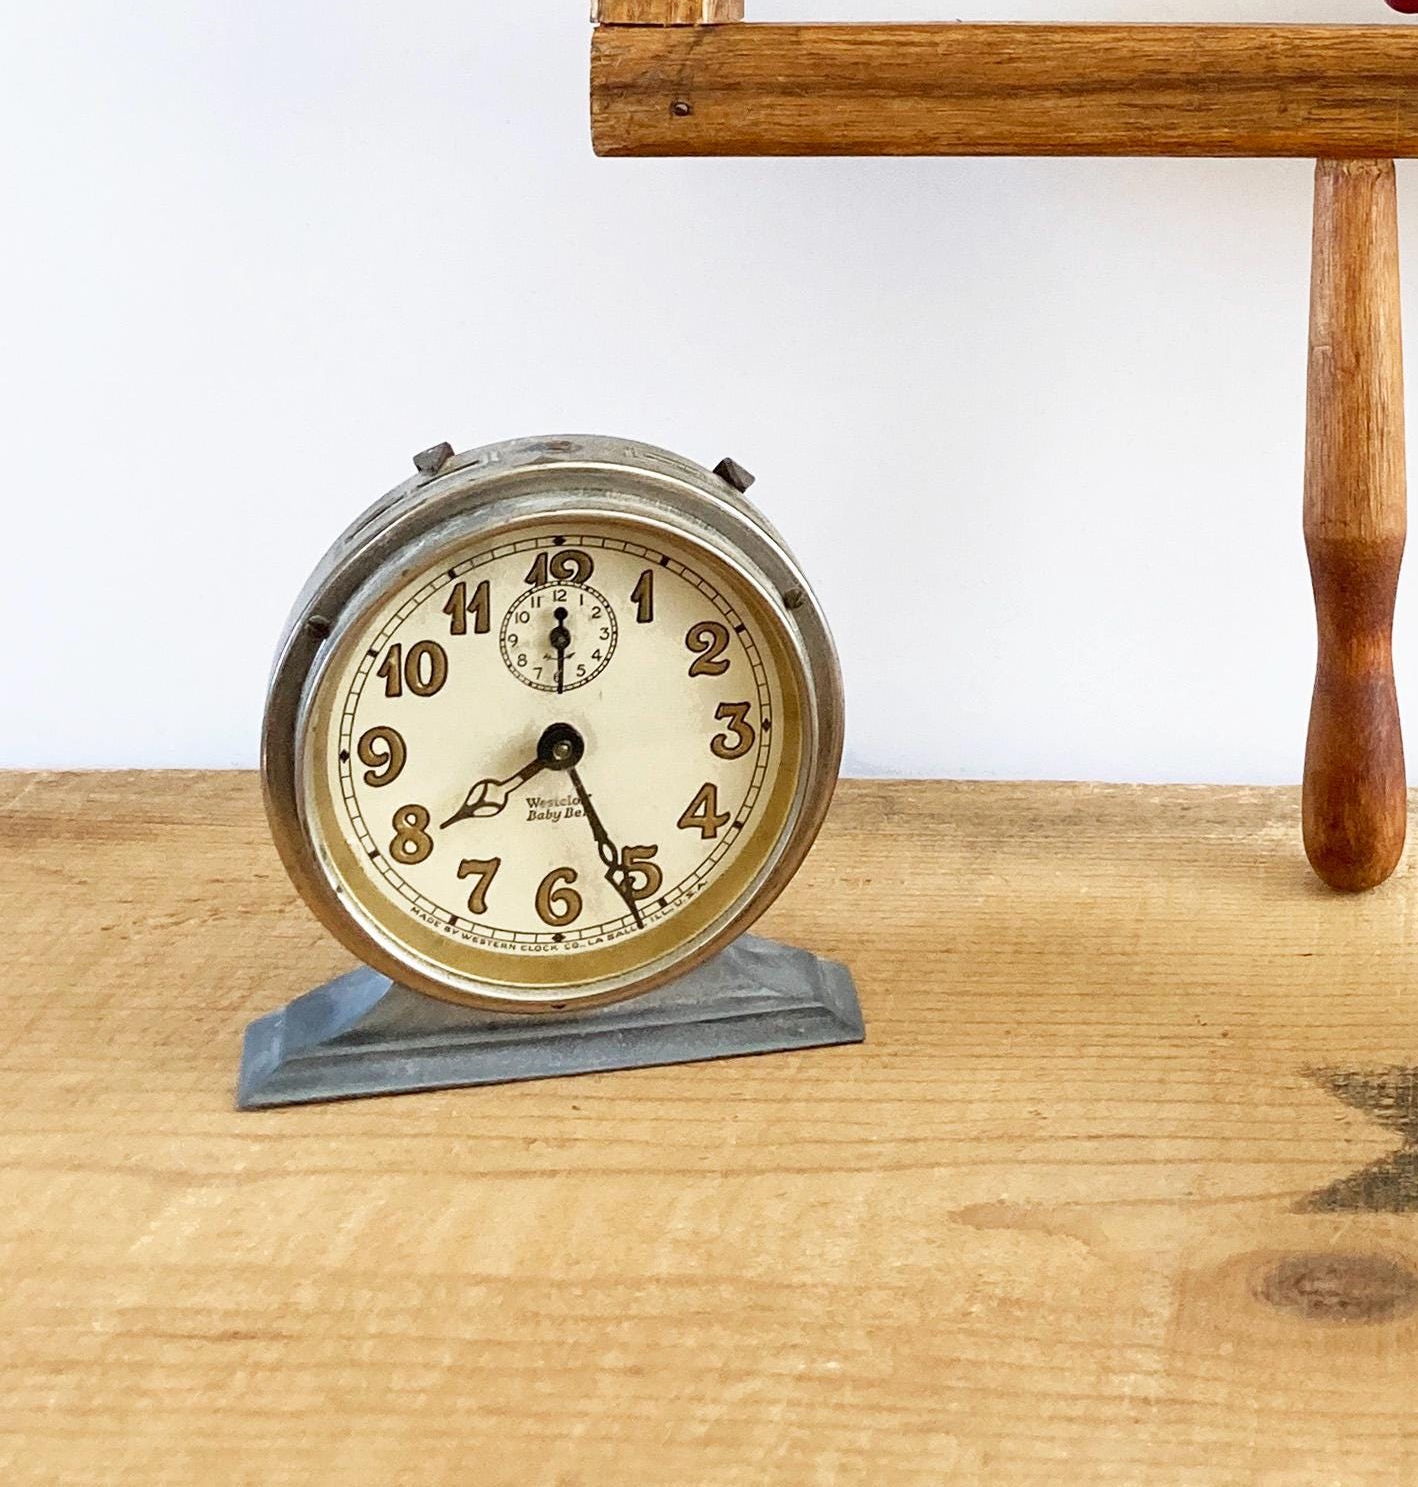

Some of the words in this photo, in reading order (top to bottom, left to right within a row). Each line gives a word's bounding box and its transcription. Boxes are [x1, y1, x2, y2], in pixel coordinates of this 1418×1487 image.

[531, 595, 543, 609] 11
[553, 588, 568, 603] 12
[579, 593, 584, 606] 1
[631, 569, 654, 623] 1
[443, 580, 491, 634] 11
[591, 606, 602, 619] 2
[515, 610, 531, 624] 10
[507, 633, 519, 648] 9
[599, 627, 610, 641] 3
[591, 648, 603, 662] 4
[685, 621, 730, 676] 2
[517, 653, 528, 667] 8
[375, 640, 449, 698] 10
[533, 667, 543, 680] 7
[576, 664, 587, 677] 5
[710, 702, 755, 760] 3
[357, 726, 407, 788] 9
[526, 795, 592, 809] Westclo
[526, 809, 562, 823] Baby
[563, 807, 588, 819] Be
[677, 782, 731, 839] 4
[389, 804, 434, 864] 8
[620, 845, 663, 901] 5
[457, 857, 501, 914] 7
[535, 866, 583, 926] 6
[410, 906, 441, 927] MADE
[444, 927, 460, 935] BY
[461, 932, 516, 951] WESTERN
[588, 936, 604, 946] LA
